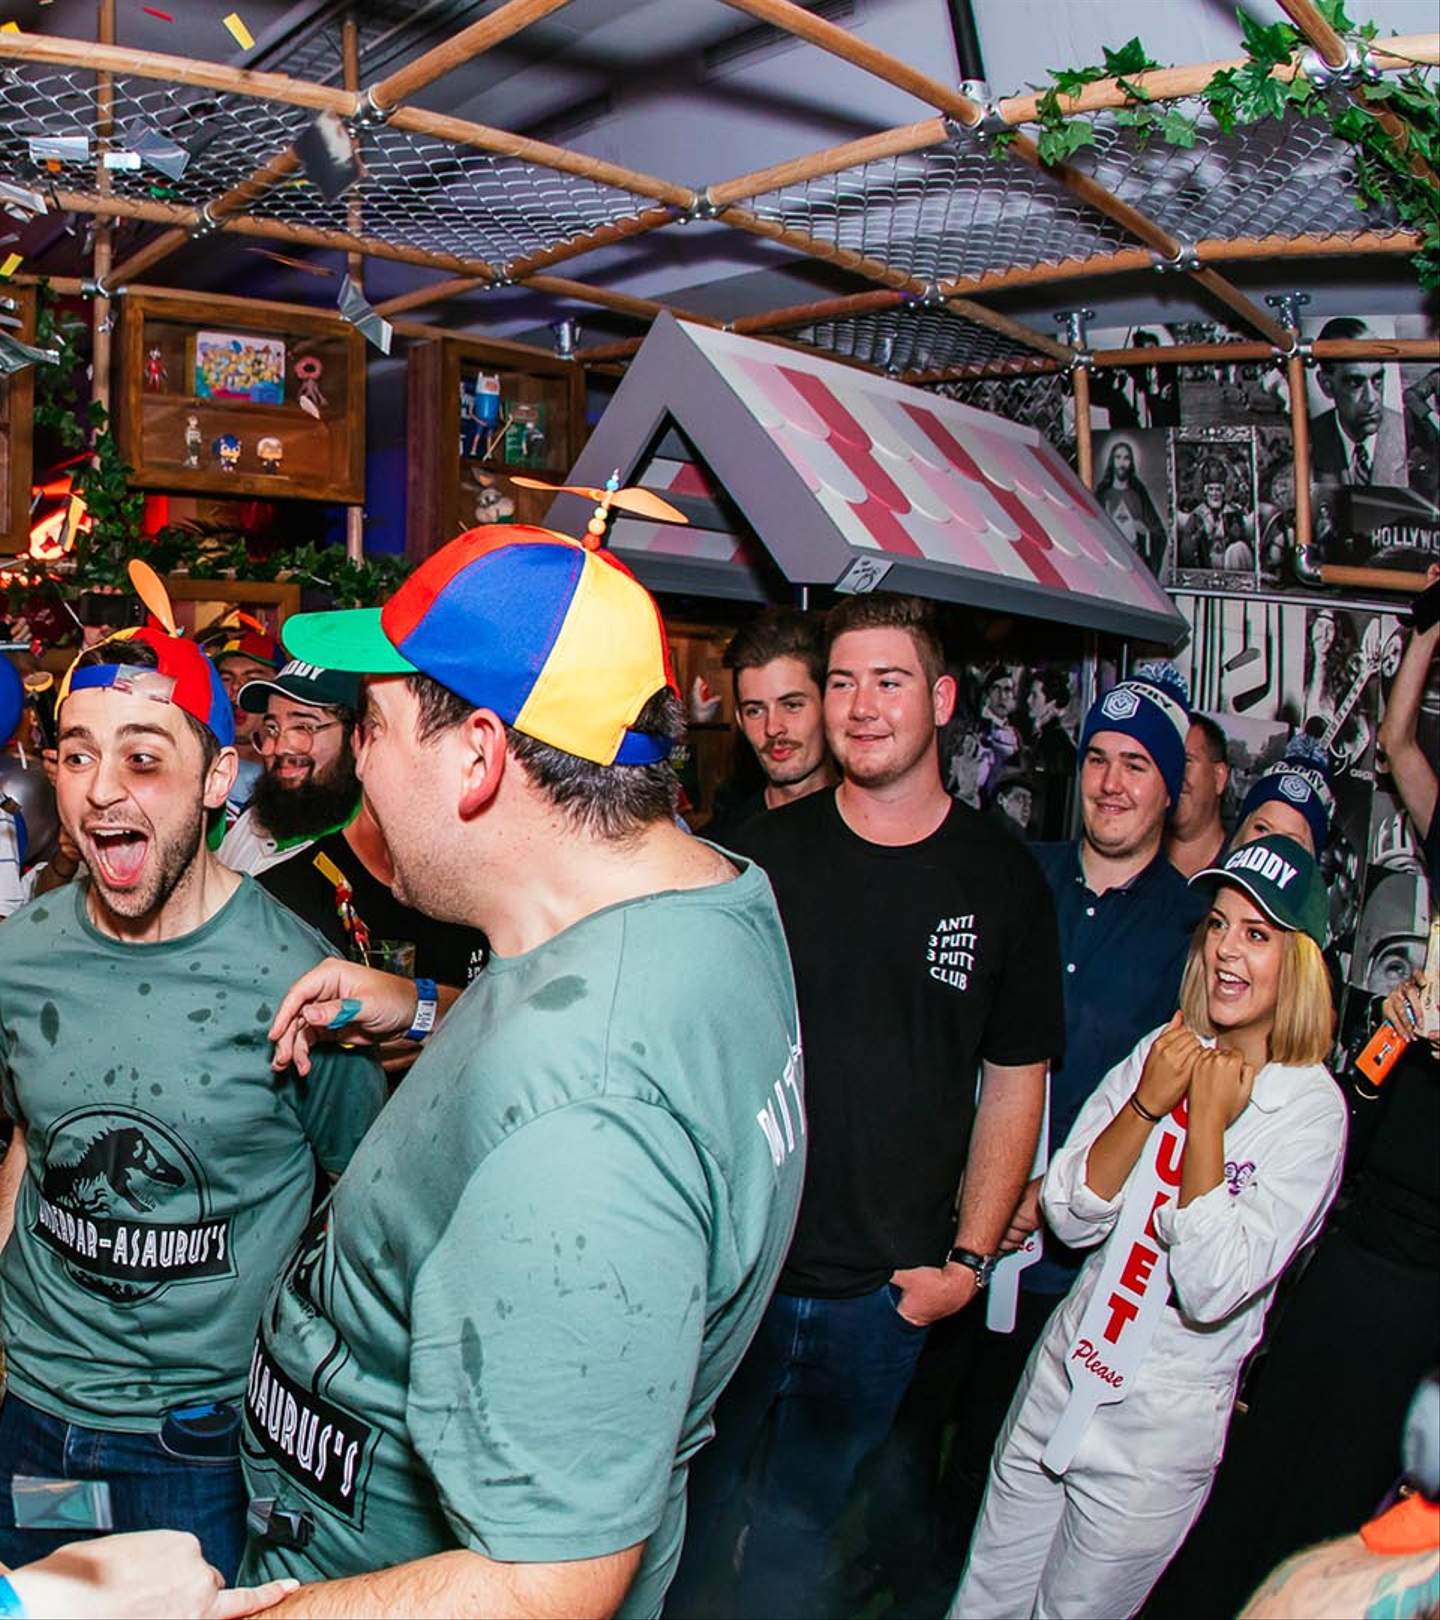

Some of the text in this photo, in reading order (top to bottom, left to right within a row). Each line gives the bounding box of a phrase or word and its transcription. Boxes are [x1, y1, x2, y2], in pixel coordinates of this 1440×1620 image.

[1224, 846, 1298, 889] CADDY
[936, 914, 975, 932] ANTI
[928, 933, 978, 950] 3 PUTT
[926, 948, 975, 971] 3 PUTT
[929, 966, 968, 991] CLUB
[1071, 1339, 1125, 1389] Please
